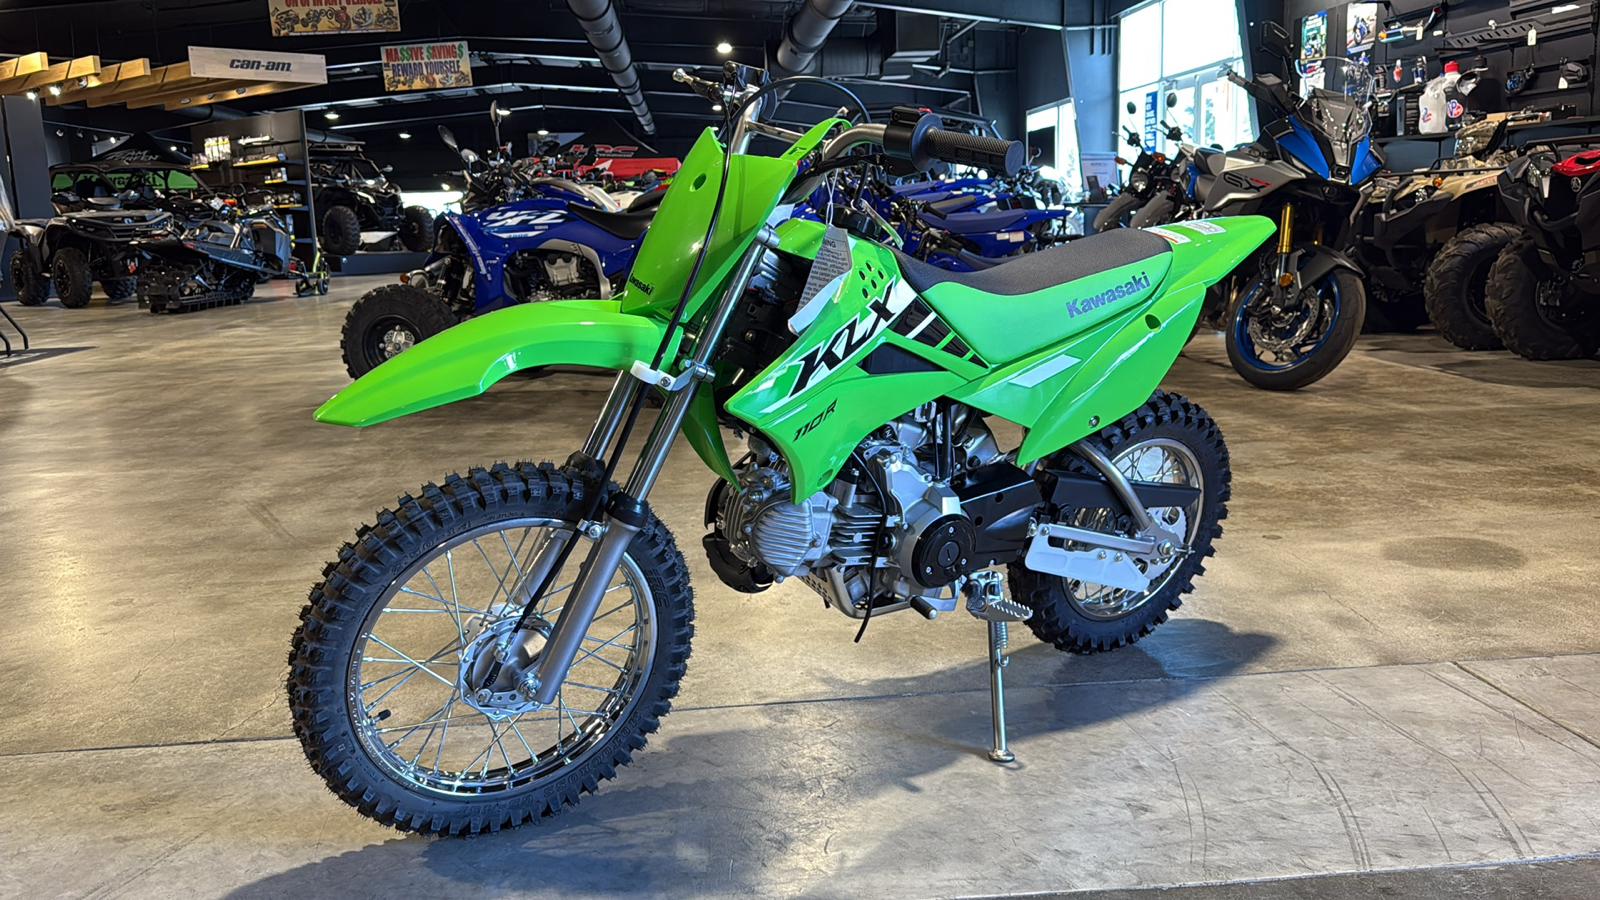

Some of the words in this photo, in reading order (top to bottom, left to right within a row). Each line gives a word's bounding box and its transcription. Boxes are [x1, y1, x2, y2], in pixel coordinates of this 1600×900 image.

[229, 59, 292, 72] can-am
[385, 46, 424, 62] MA$$IVE
[426, 43, 464, 61] $AVING$
[391, 62, 423, 77] REWARD
[424, 60, 461, 76] YOURSELF
[1066, 271, 1151, 318] Kawasaki
[789, 280, 896, 398] KLX
[793, 398, 838, 442] 110R
[543, 710, 643, 798] MOTOCROSS
